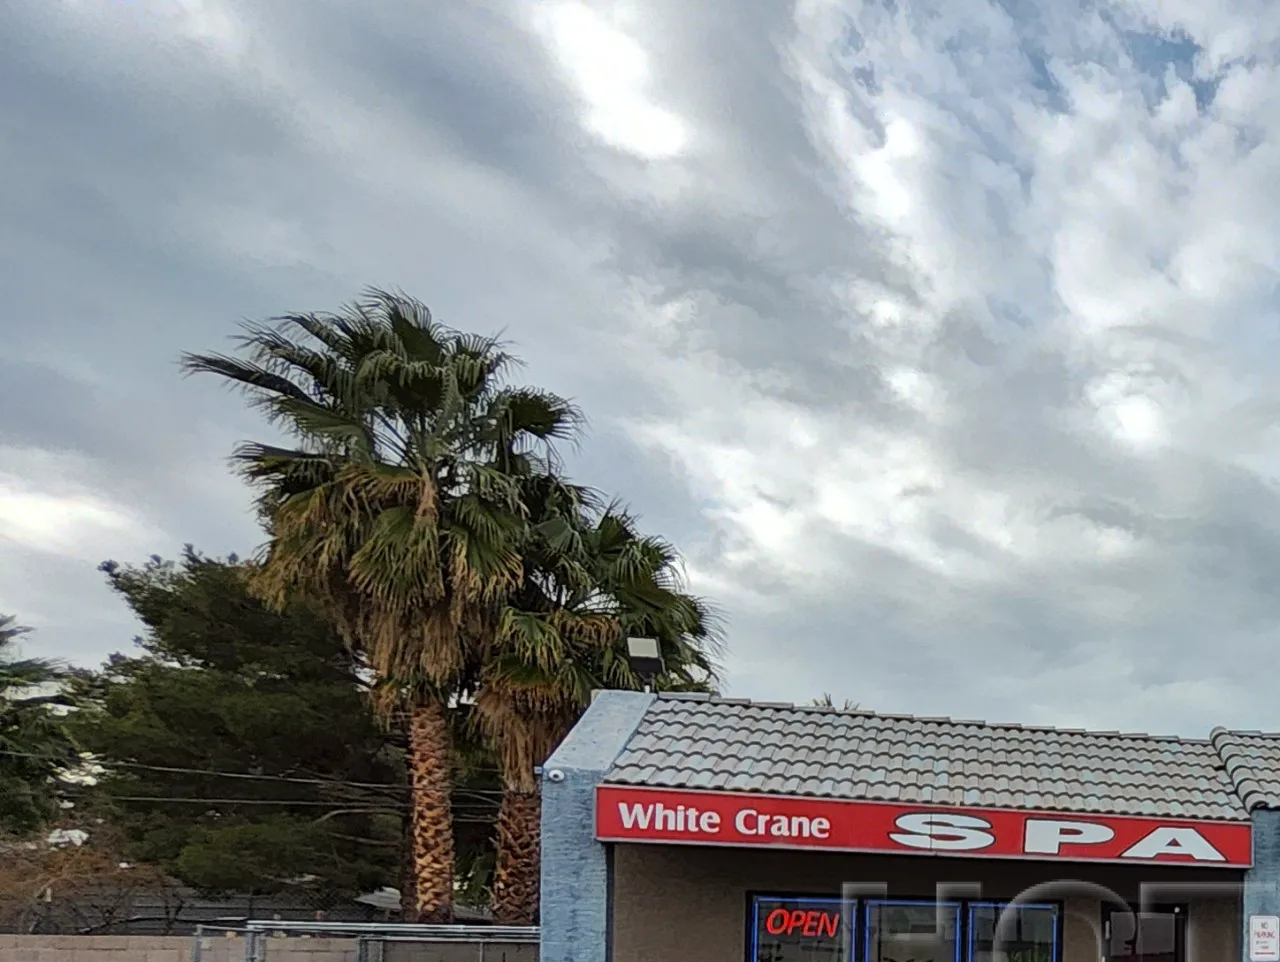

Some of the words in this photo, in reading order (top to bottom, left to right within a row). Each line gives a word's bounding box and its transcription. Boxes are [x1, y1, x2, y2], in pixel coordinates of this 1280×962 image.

[618, 802, 721, 833] White
[735, 809, 830, 838] Crane
[887, 811, 1229, 863] SPA
[766, 908, 839, 937] OPEN
